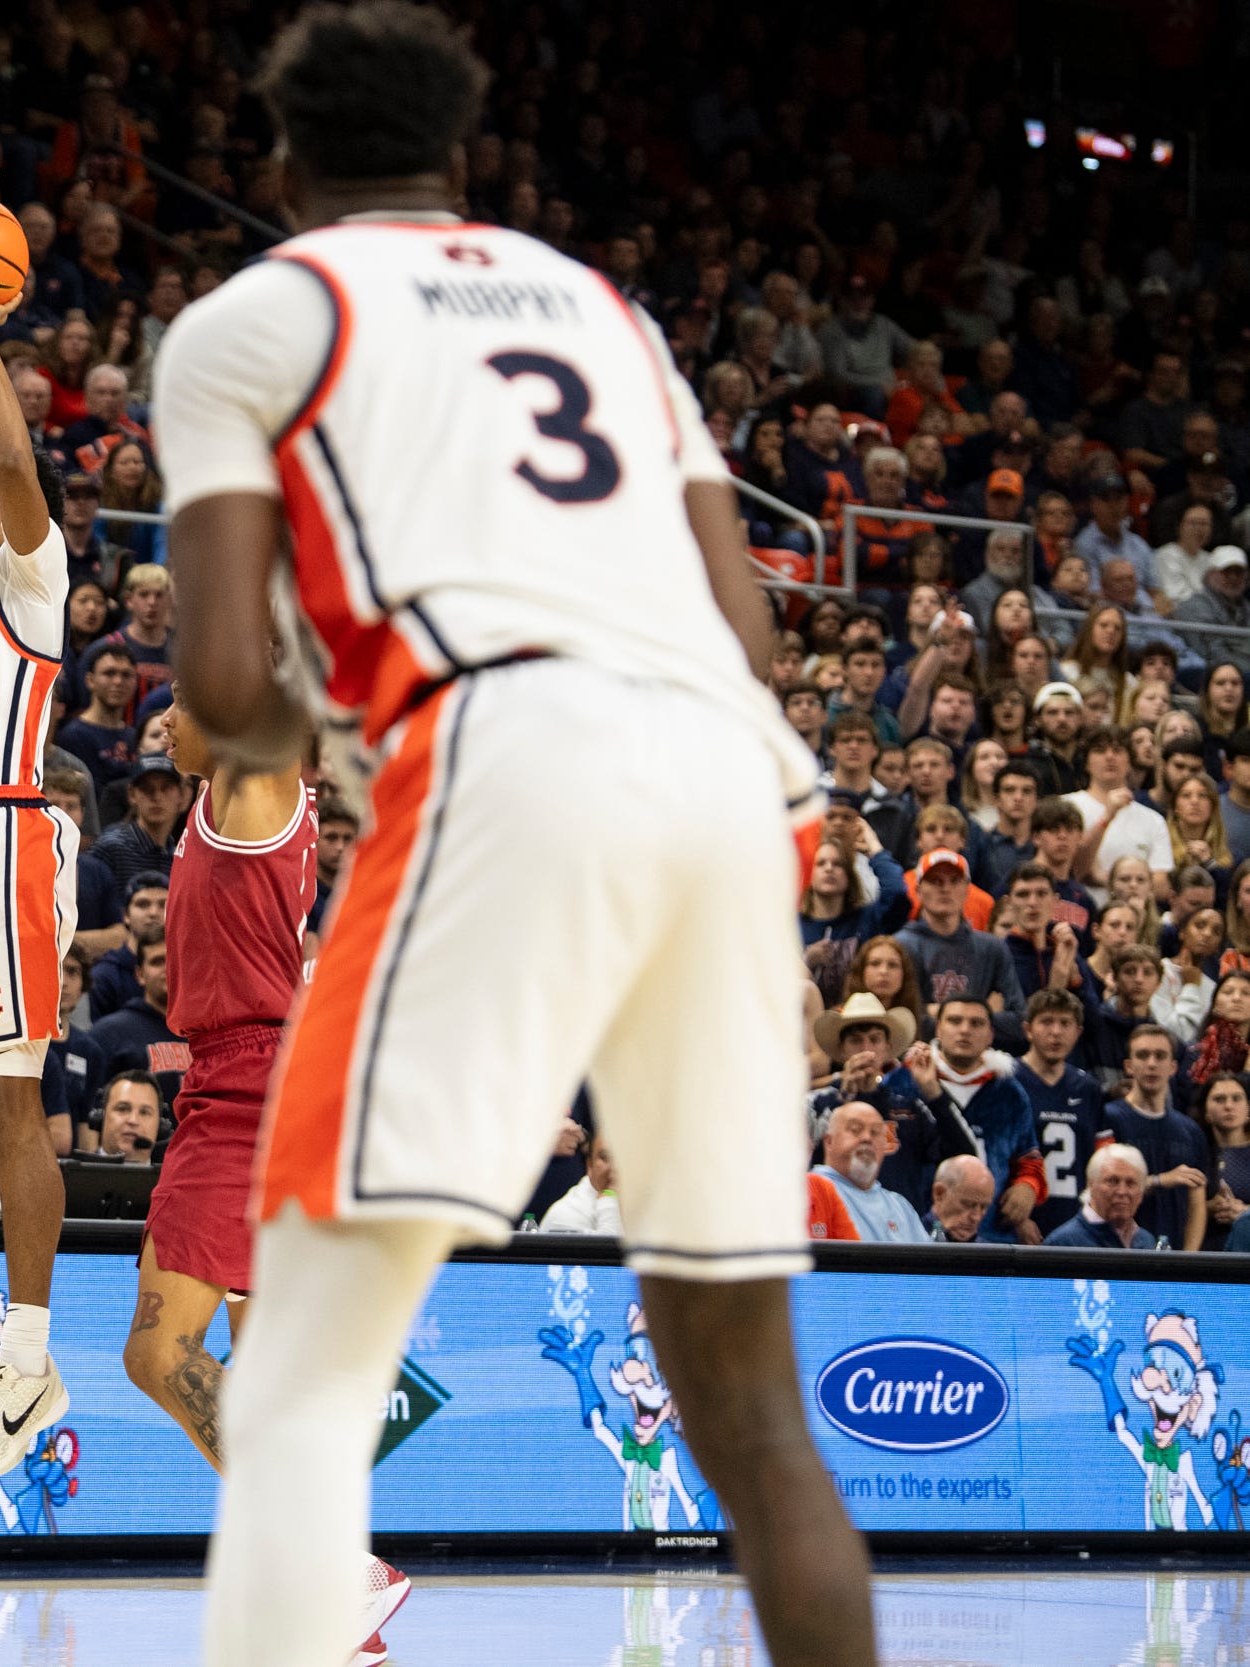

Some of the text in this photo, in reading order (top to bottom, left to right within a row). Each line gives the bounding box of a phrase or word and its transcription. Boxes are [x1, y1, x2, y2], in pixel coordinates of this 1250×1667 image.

[484, 350, 623, 505] 3
[1042, 1121, 1078, 1198] 2
[844, 1367, 985, 1416] Carrier
[838, 1472, 1012, 1504] urn to the experts
[655, 1536, 719, 1548] DAKTRONICS
